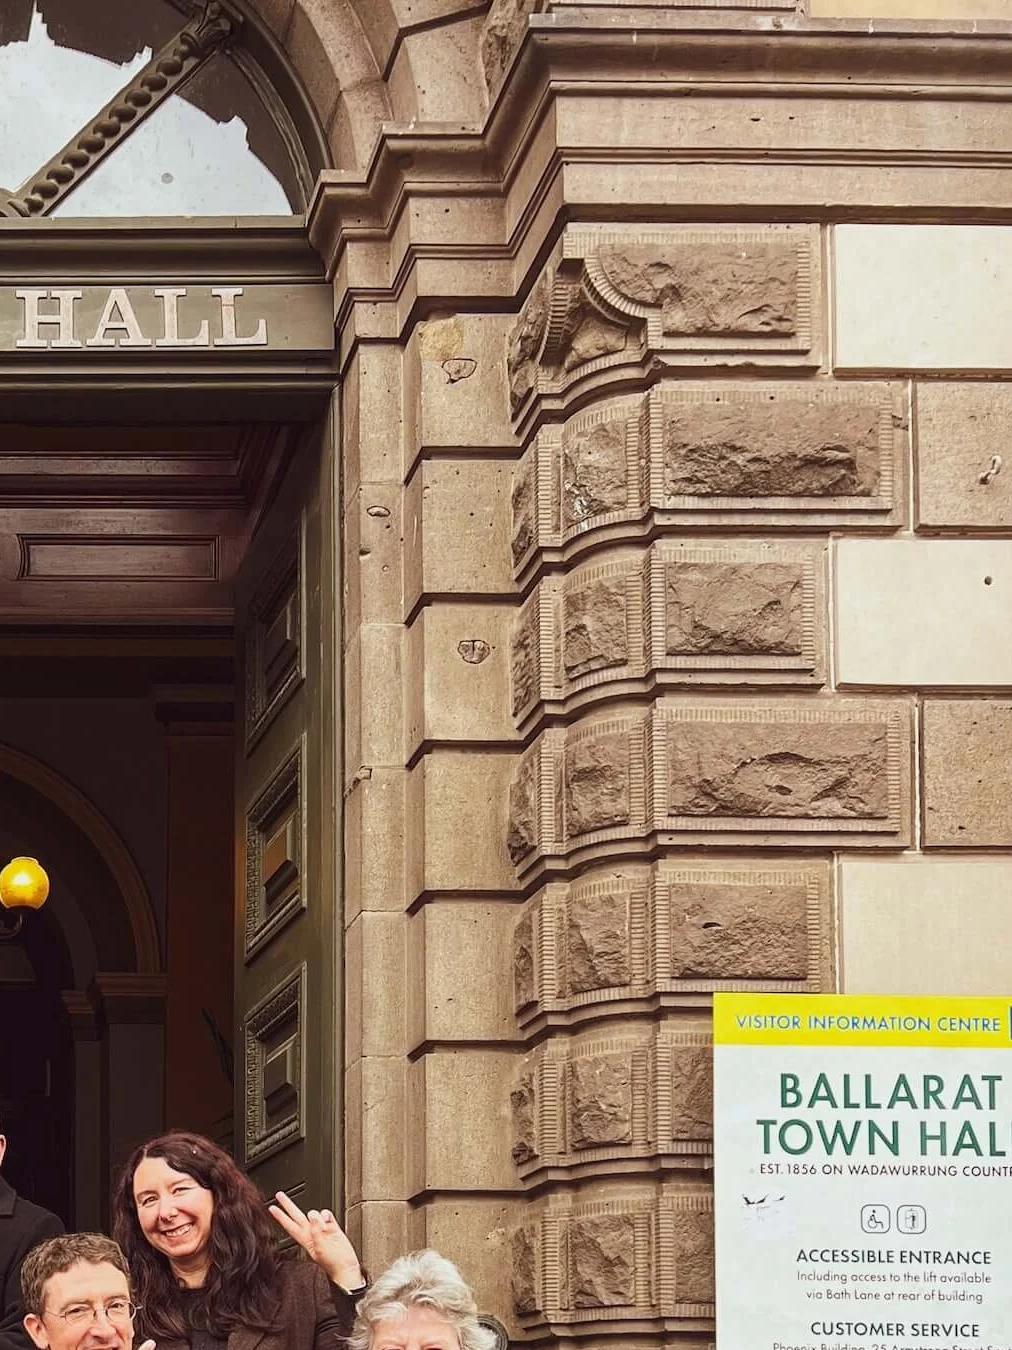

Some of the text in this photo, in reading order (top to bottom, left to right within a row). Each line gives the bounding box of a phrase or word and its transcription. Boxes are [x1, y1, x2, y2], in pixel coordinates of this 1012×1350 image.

[15, 286, 269, 349] HALL
[737, 1015, 1000, 1032] VISITOR INFORMATION CENTRE
[780, 1073, 1002, 1110] BALLARAT
[756, 1119, 1012, 1157] TOWN HAL
[822, 1164, 843, 1176] ON
[849, 1165, 957, 1177] WADAWURRUNG
[963, 1166, 1012, 1177] COUNT
[796, 1250, 992, 1265] ACCESSIBLE ENTRANCE
[797, 1271, 992, 1284] Including access to the lift available
[806, 1290, 983, 1304] via Bath Lane at rear of building
[811, 1322, 980, 1338] CUSTOMER SERVICE
